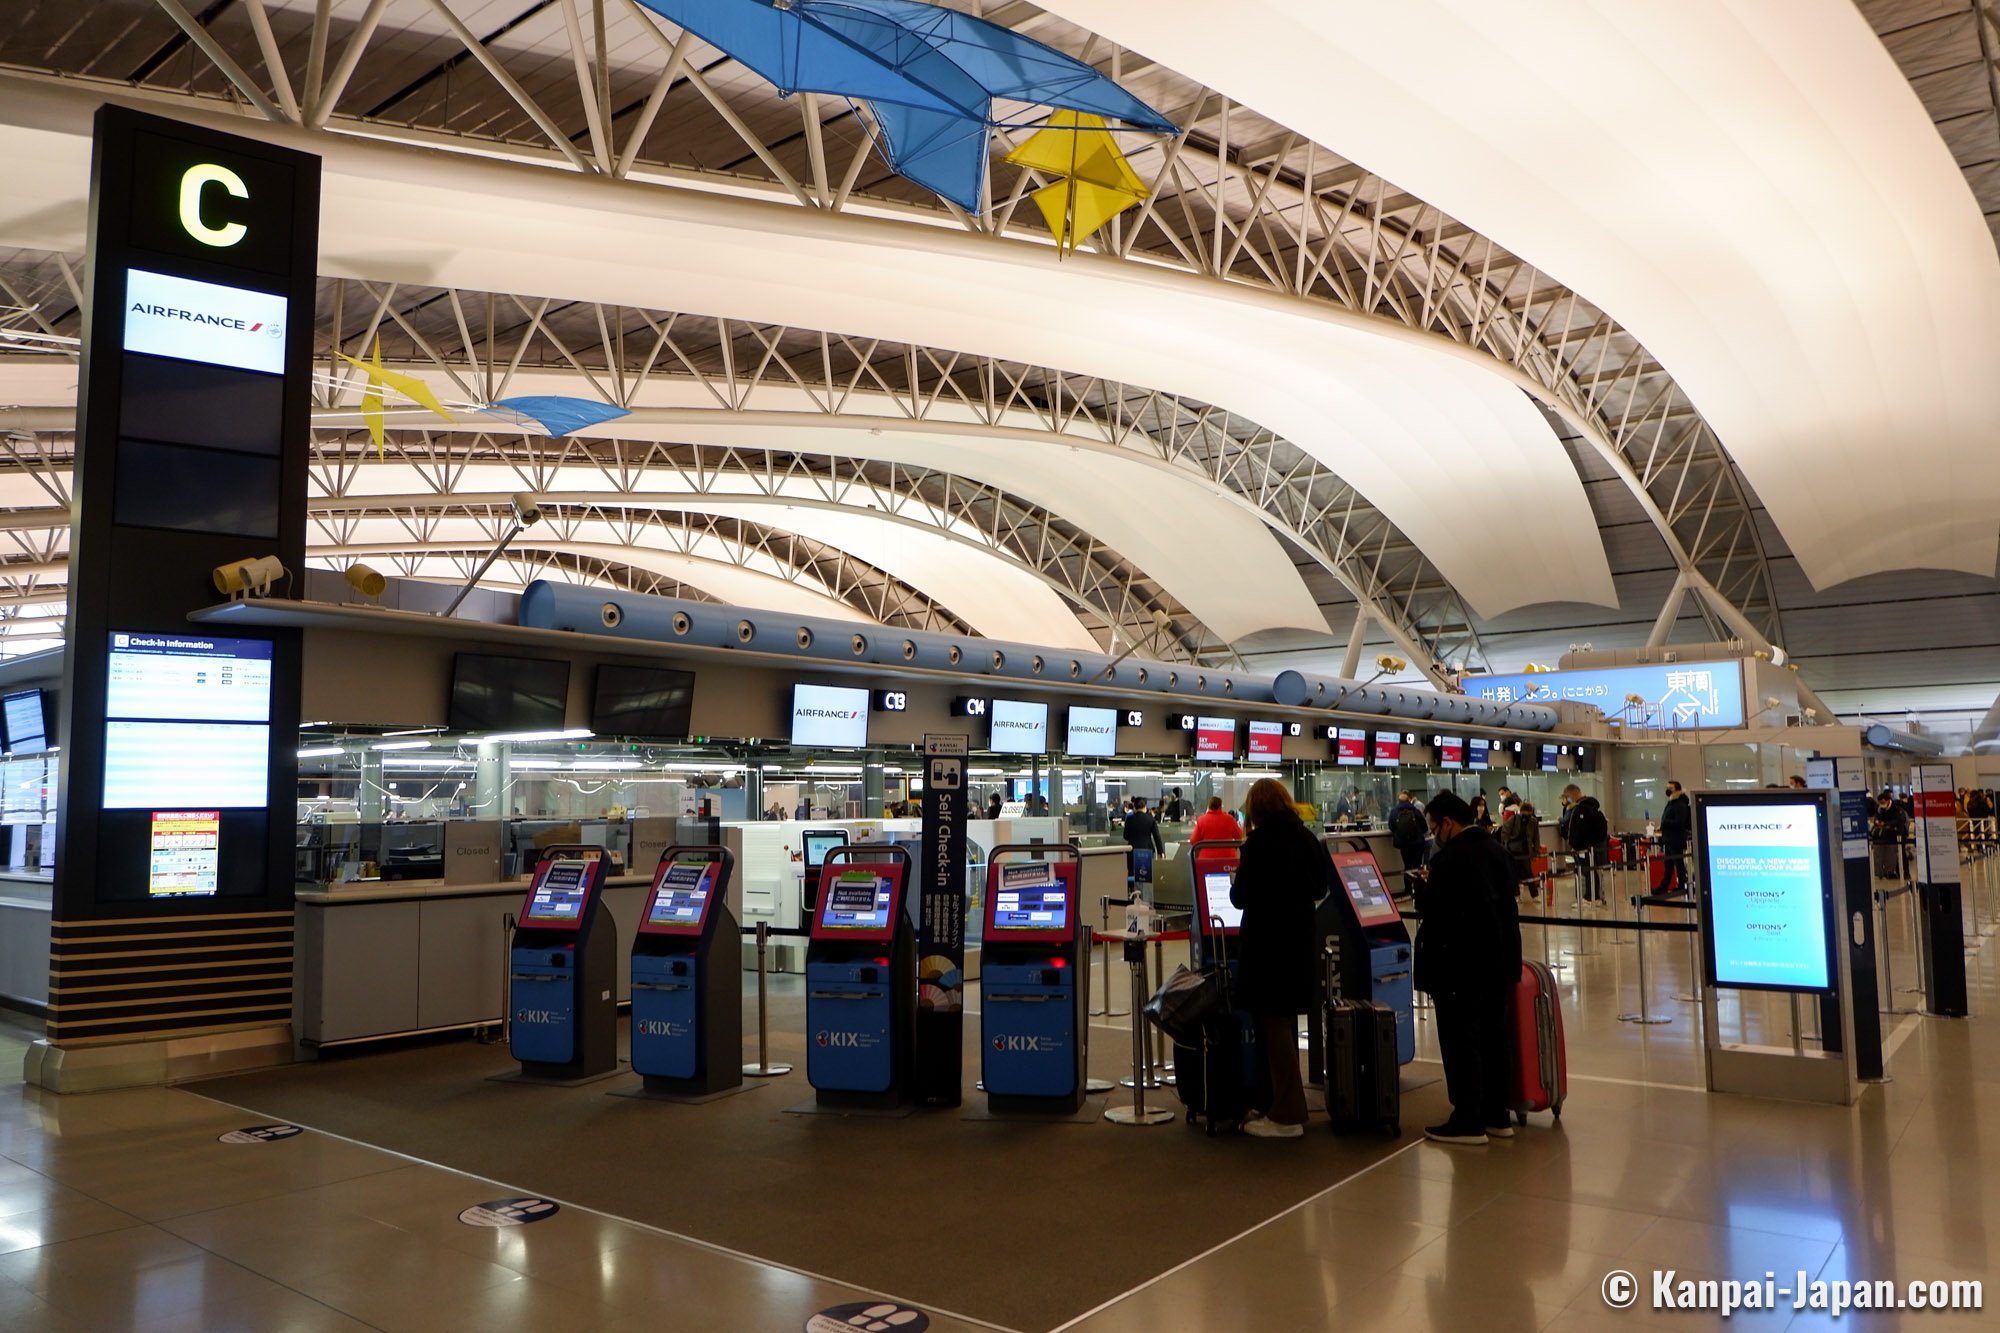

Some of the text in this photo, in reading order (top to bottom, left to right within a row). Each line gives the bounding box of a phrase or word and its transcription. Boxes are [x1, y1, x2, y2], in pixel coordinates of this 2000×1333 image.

[179, 163, 250, 248] C
[131, 302, 246, 331] AIRFRANCE
[129, 637, 165, 648] Check-in
[166, 639, 214, 650] Information
[885, 692, 906, 711] C13
[966, 698, 985, 715] C14
[795, 708, 849, 719] AIRFRANCE
[1128, 710, 1142, 726] C15
[993, 720, 1033, 730] AIRFRANCE
[1069, 725, 1104, 734] AIRFRANCE
[1001, 805, 1024, 814] CLOSED
[1718, 823, 1783, 831] AIRFRANCE
[639, 840, 667, 849] Closed
[937, 793, 951, 886] Self Check-in
[456, 846, 490, 856] Closed
[1716, 857, 1757, 865] DISCOVER
[1758, 857, 1765, 865] A
[1767, 857, 1786, 865] NEW
[1746, 923, 1782, 931] OPTIONS
[527, 1010, 550, 1024] KIX
[648, 1020, 672, 1036] KIX
[830, 1031, 859, 1047] KIX
[1007, 1035, 1040, 1051] KIX
